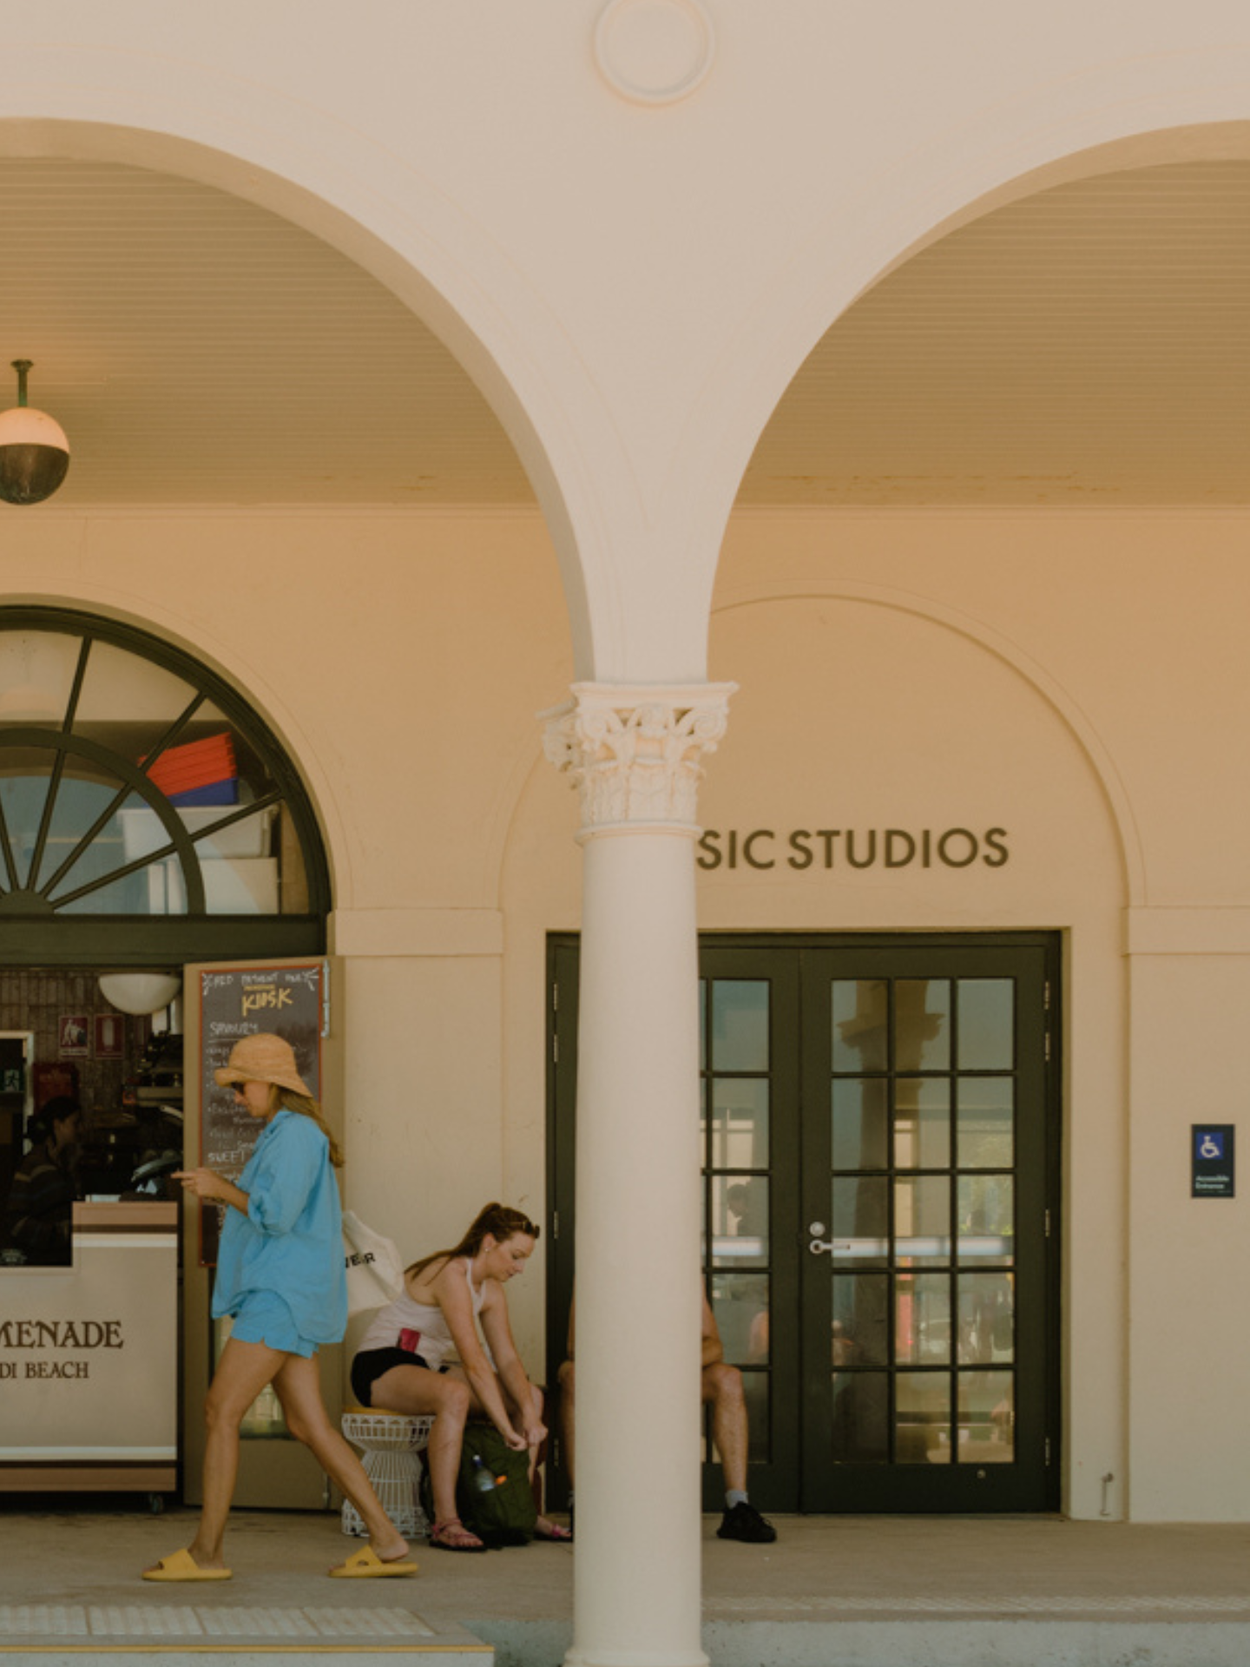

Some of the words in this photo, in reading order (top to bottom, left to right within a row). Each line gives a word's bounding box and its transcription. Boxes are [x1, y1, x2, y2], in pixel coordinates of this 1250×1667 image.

[787, 827, 1009, 870] STUDIOS
[241, 987, 293, 1016] KIOSK
[25, 1361, 90, 1379] BEACH
